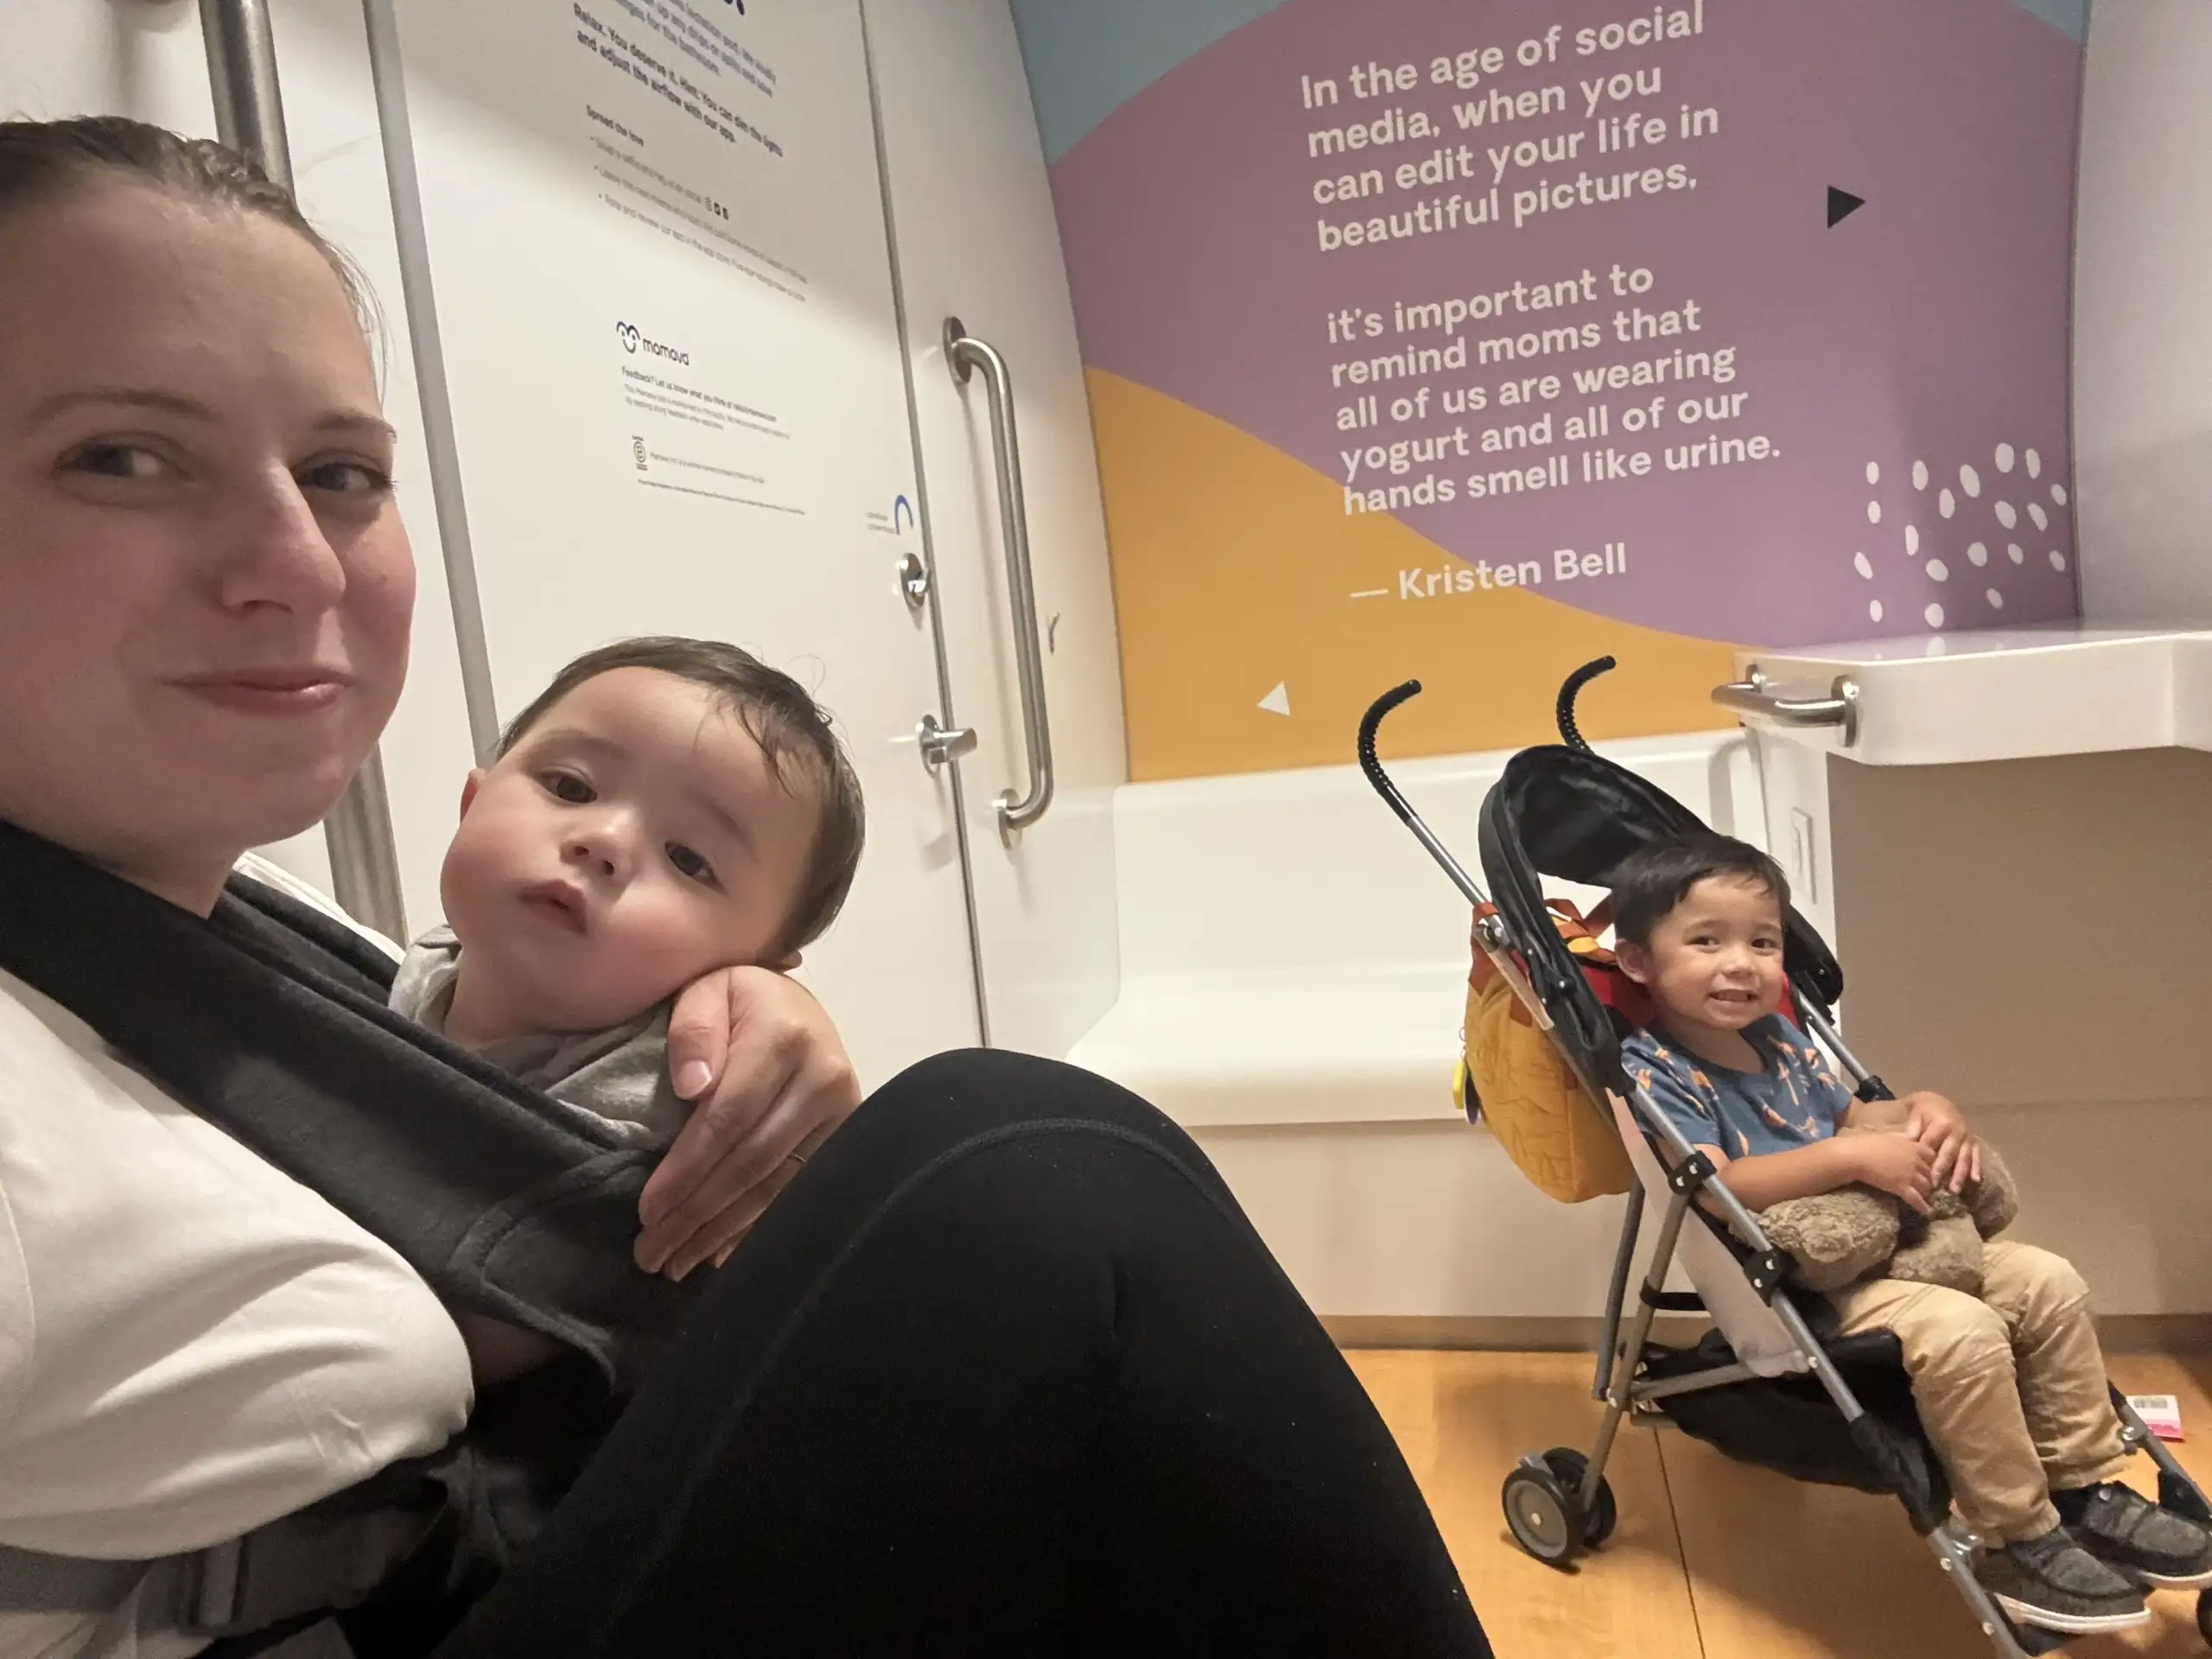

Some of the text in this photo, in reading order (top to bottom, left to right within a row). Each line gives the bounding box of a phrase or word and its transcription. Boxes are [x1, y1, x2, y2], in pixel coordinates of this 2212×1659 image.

[1300, 0, 1703, 110] In the age of social
[1308, 67, 1662, 158] media, when you
[1313, 104, 1719, 205] can edit your life in
[1317, 187, 1499, 252] beautiful
[1327, 264, 1654, 344] it's important to
[1332, 299, 1701, 388] remind moms that
[642, 338, 690, 365] mamava
[1336, 346, 1737, 430] all of us are wearing
[1339, 391, 1749, 484] yogurt and all of our
[1343, 434, 1781, 516] hands smell like urine.
[1398, 559, 1542, 601] Kristen
[1554, 542, 1626, 582] Bell
